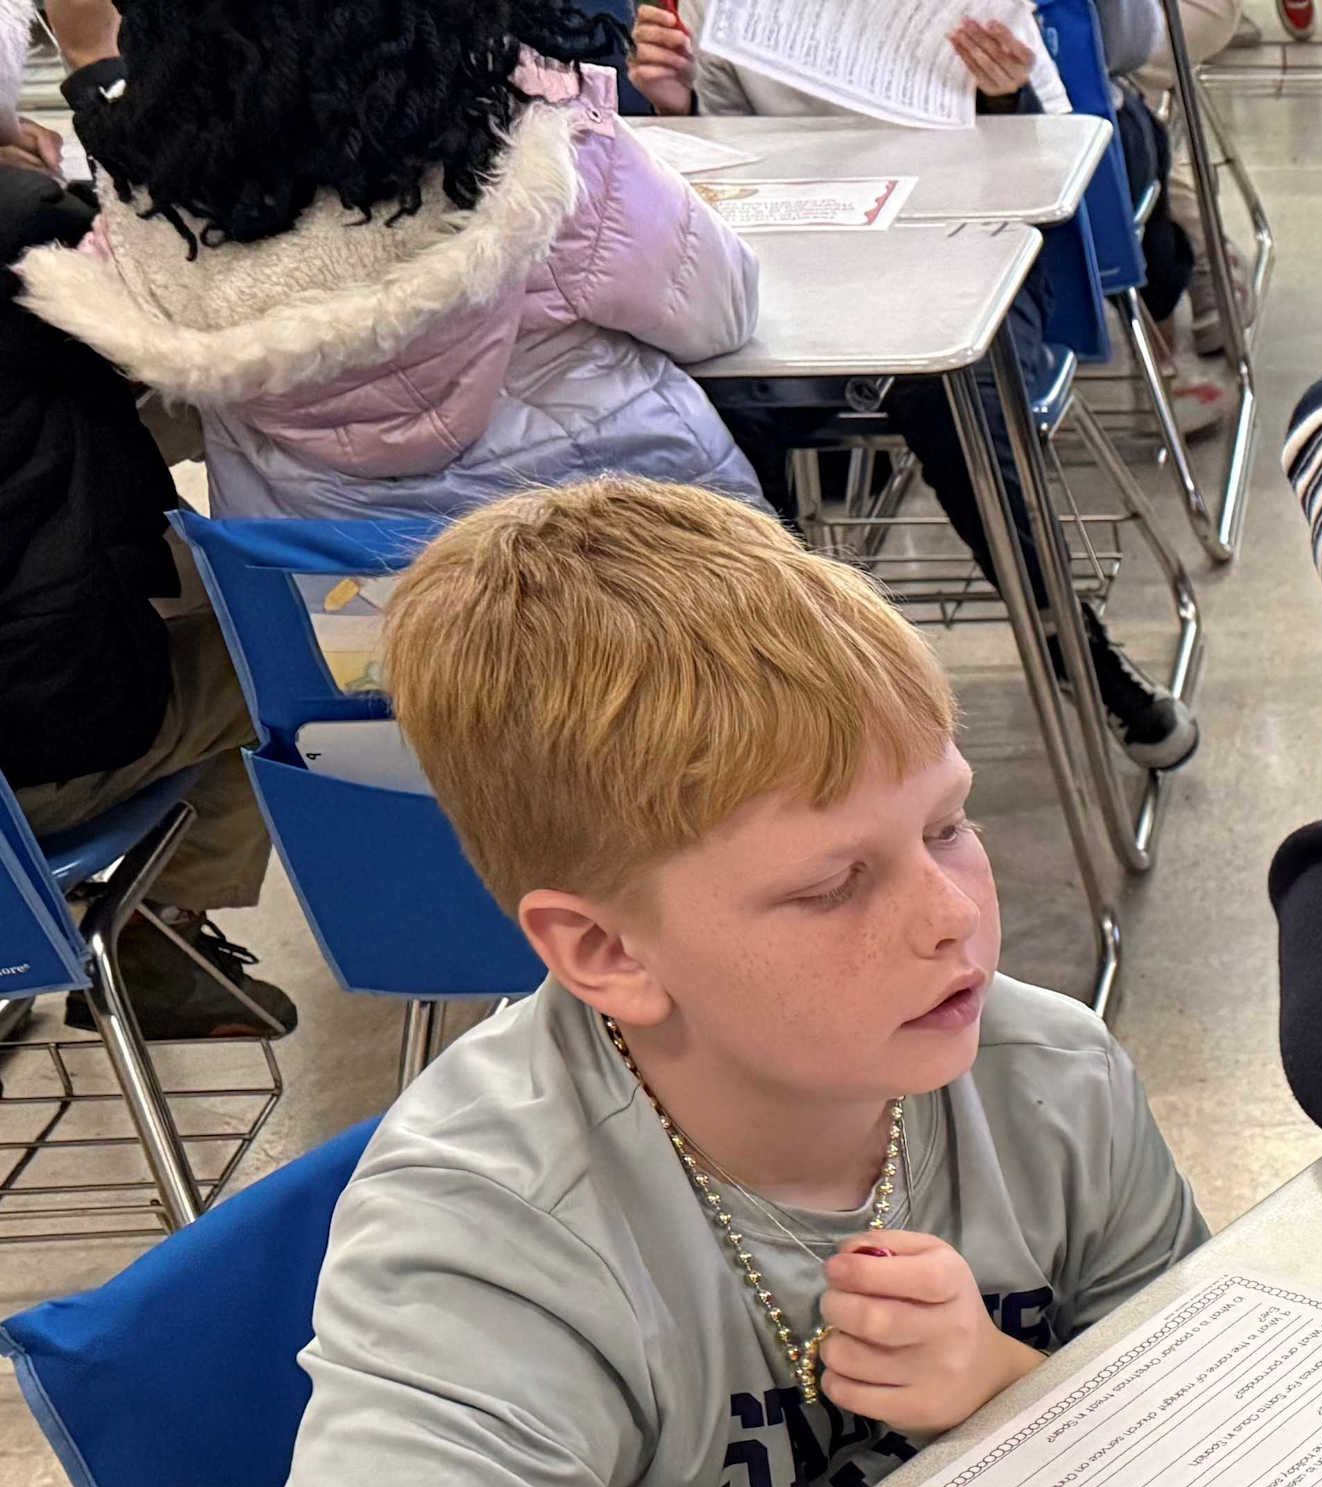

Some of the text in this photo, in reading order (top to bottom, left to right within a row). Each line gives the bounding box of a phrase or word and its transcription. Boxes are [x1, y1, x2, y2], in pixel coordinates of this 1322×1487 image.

[1256, 1316, 1283, 1334] What
[1230, 1340, 1250, 1353] the
[1205, 1352, 1233, 1373] name
[1156, 1382, 1195, 1411] midnight
[1122, 1411, 1157, 1436] church
[1087, 1435, 1125, 1462] service
